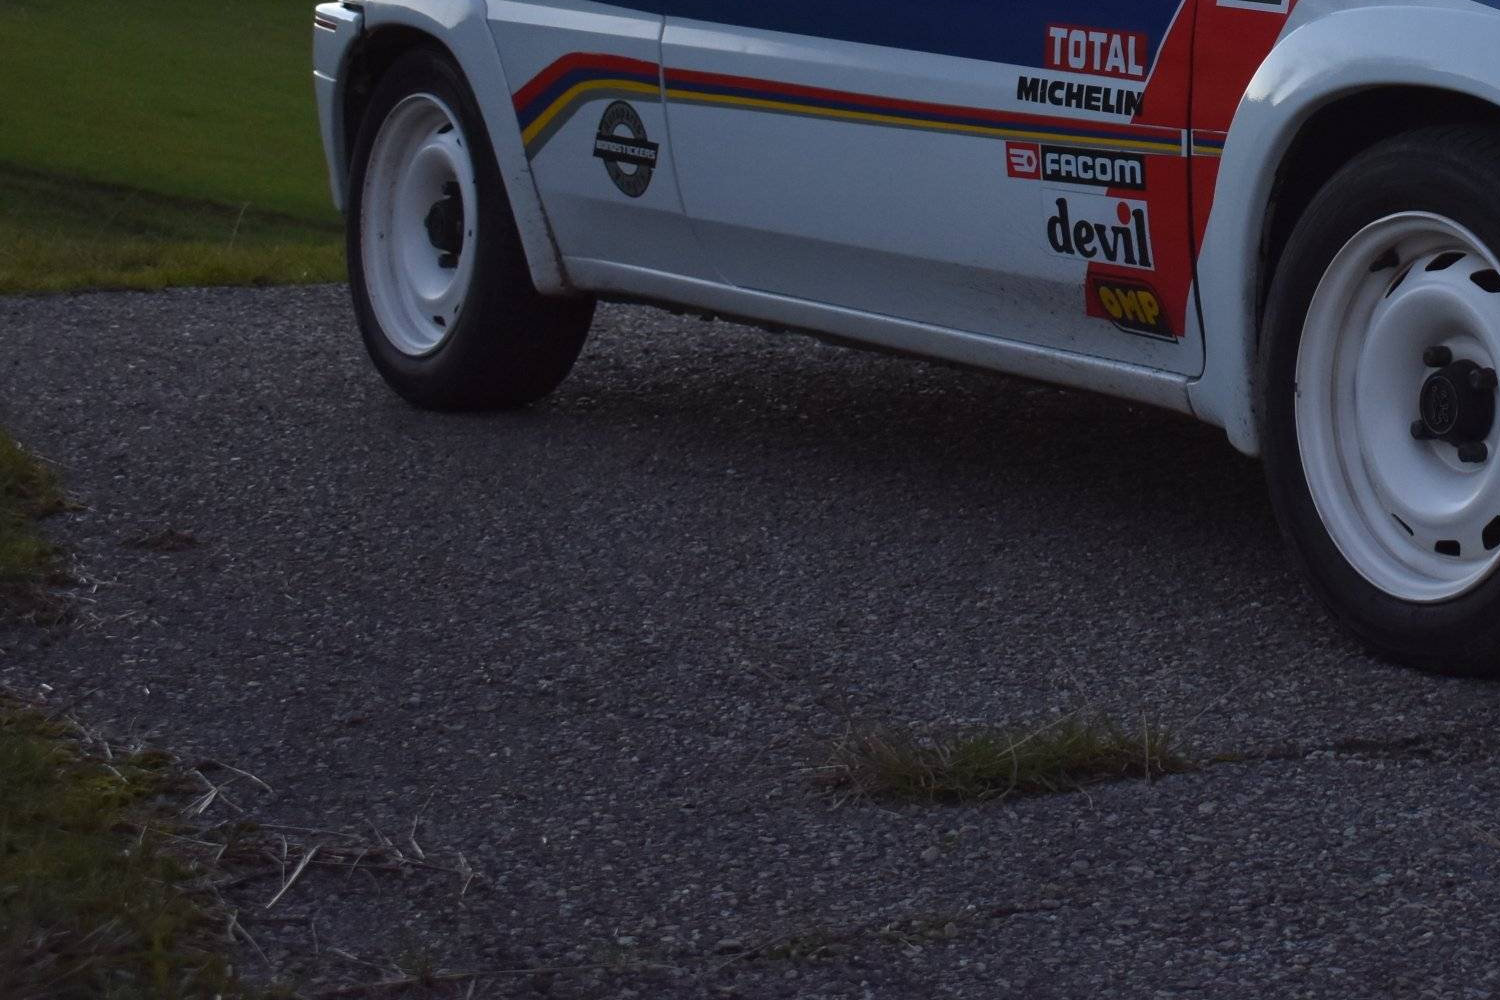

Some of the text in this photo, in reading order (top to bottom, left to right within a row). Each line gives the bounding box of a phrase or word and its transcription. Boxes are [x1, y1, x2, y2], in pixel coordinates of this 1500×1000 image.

[1049, 25, 1146, 77] TOTAL
[1016, 75, 1144, 118] MICHELIN
[1044, 151, 1143, 185] FACOM
[1046, 197, 1153, 268] devil
